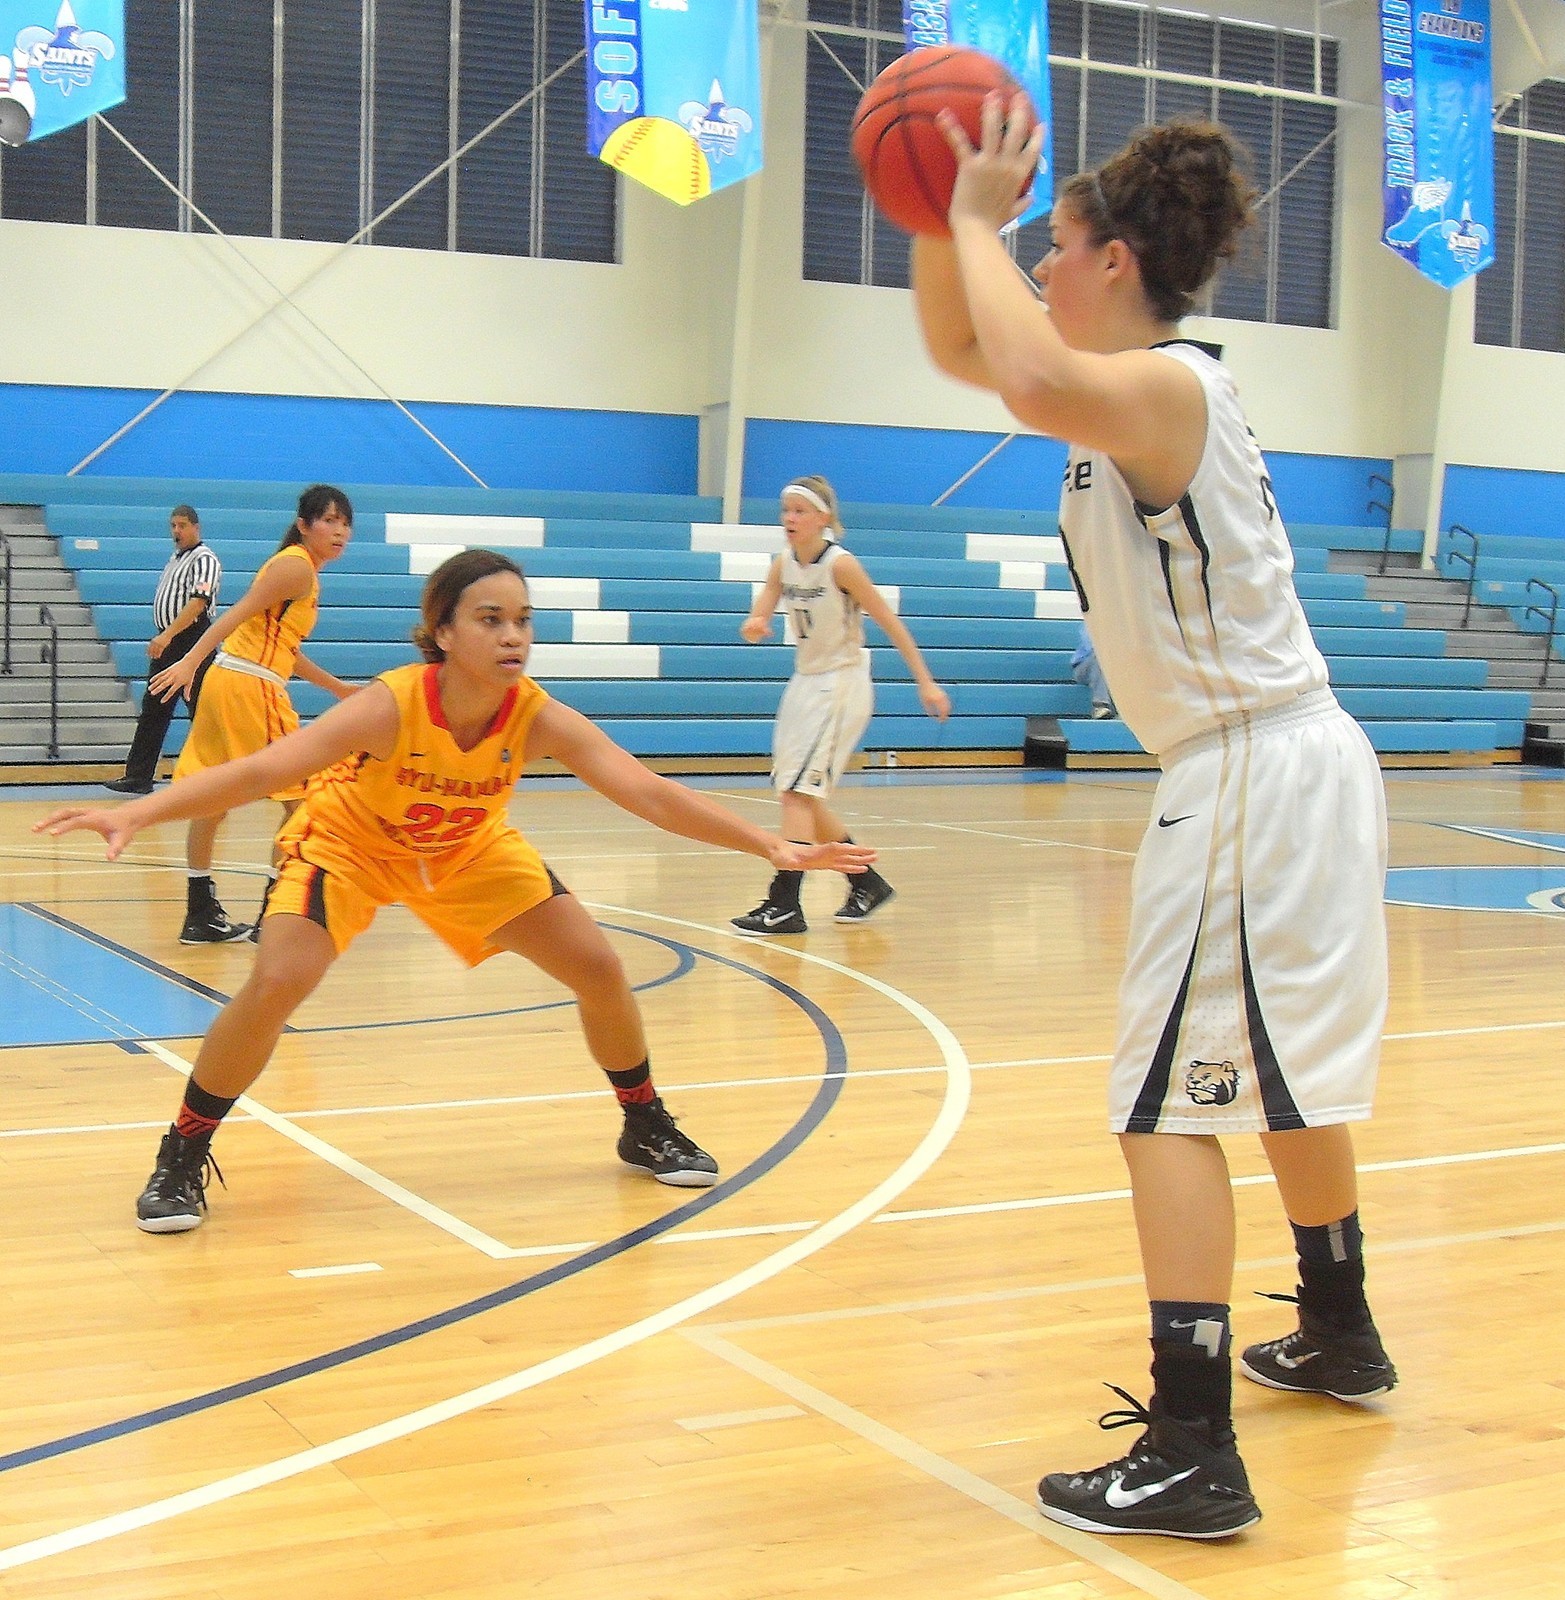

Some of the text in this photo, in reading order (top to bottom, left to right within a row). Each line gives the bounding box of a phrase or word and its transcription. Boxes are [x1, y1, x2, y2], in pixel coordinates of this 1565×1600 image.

[593, 0, 639, 114] SOF
[909, 0, 948, 51] ASK
[1382, 0, 1416, 188] TRACK & FIELD
[401, 803, 488, 843] 22
